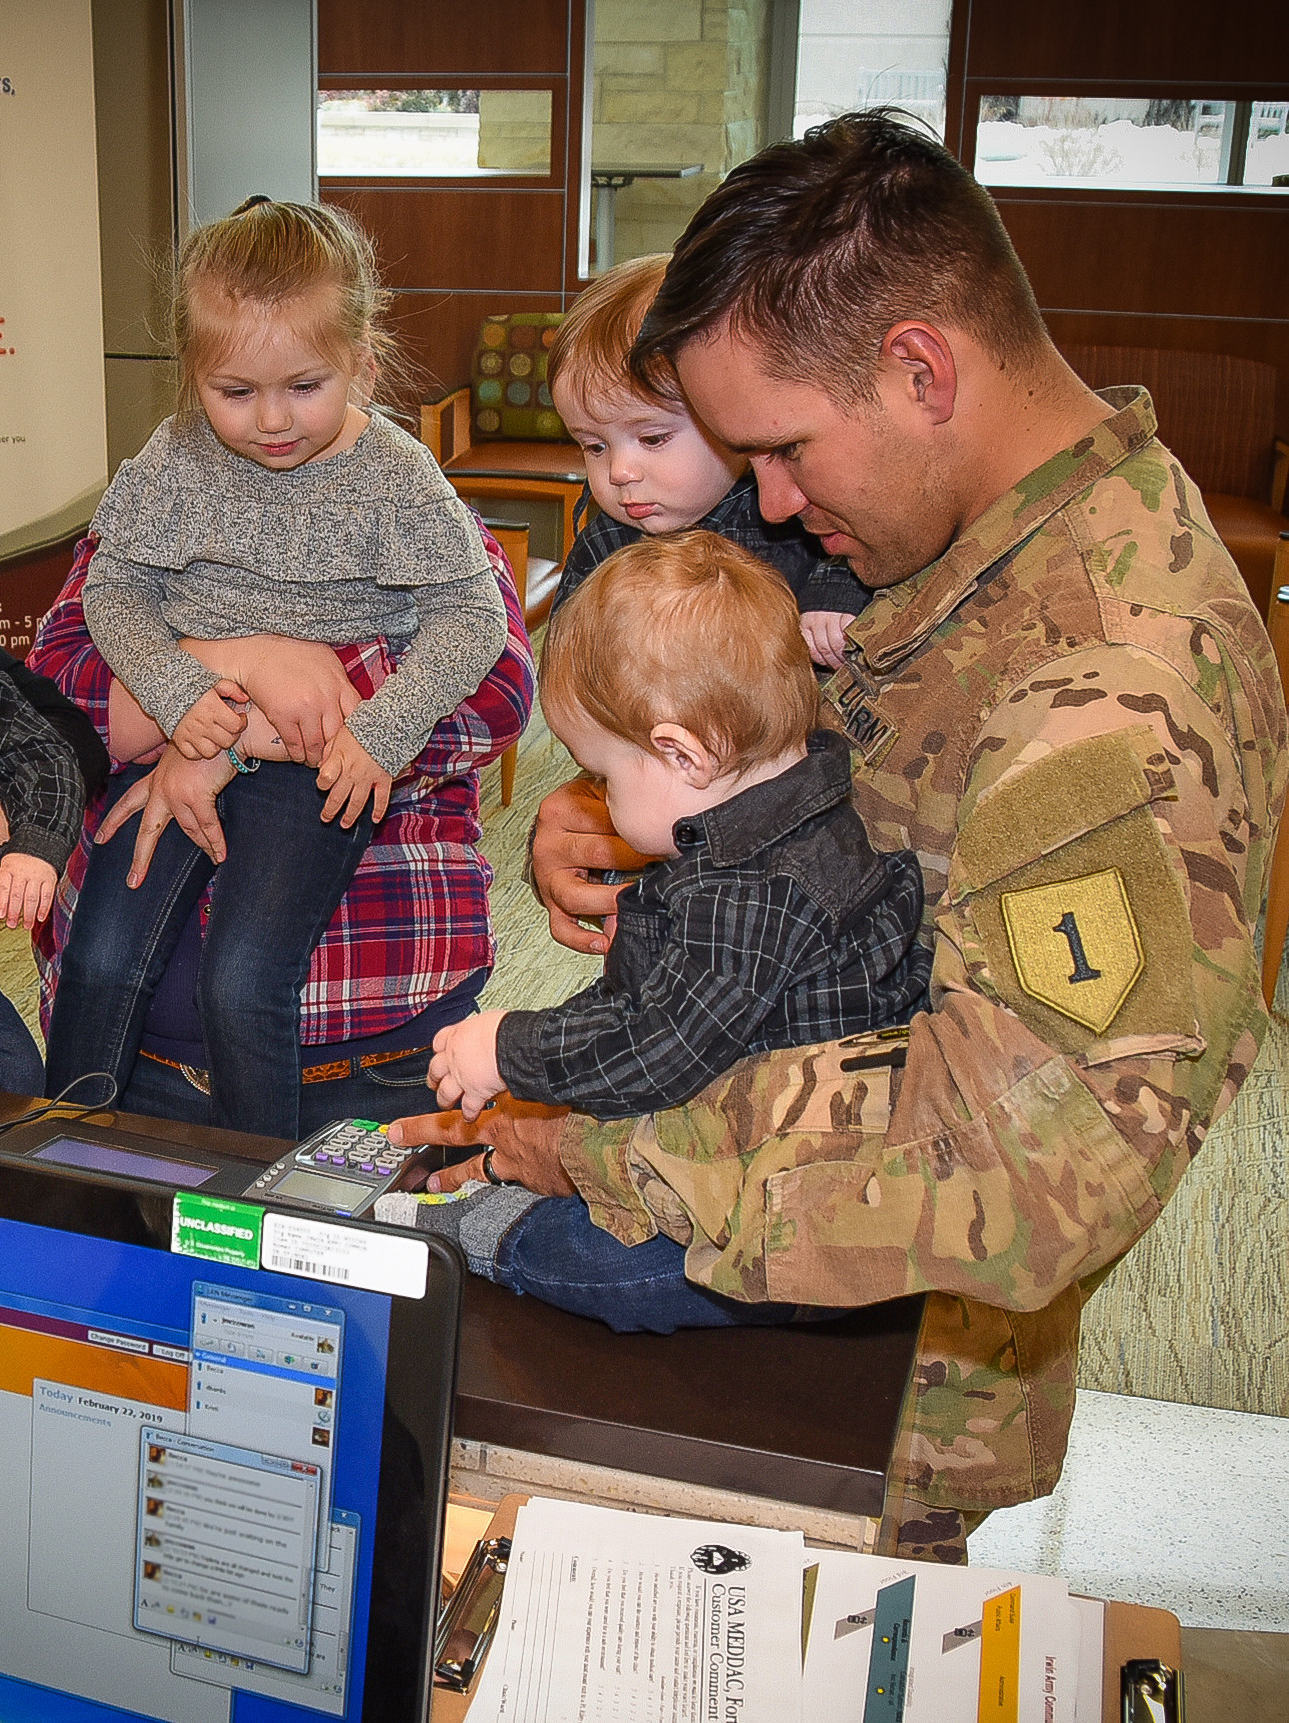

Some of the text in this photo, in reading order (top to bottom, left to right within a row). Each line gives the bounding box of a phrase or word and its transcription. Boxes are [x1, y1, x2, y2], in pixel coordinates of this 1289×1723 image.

[24, 616, 32, 628] 5
[11, 634, 31, 649] pm
[1052, 912, 1101, 985] 1
[179, 1216, 254, 1241] UNCLASSIFIED
[39, 1403, 111, 1428] Announcements
[40, 1386, 163, 1424] Today February 22, 2019
[727, 1586, 746, 1617] USA
[708, 1583, 726, 1721] Customer Comment
[723, 1622, 745, 1692] MEDDAC,
